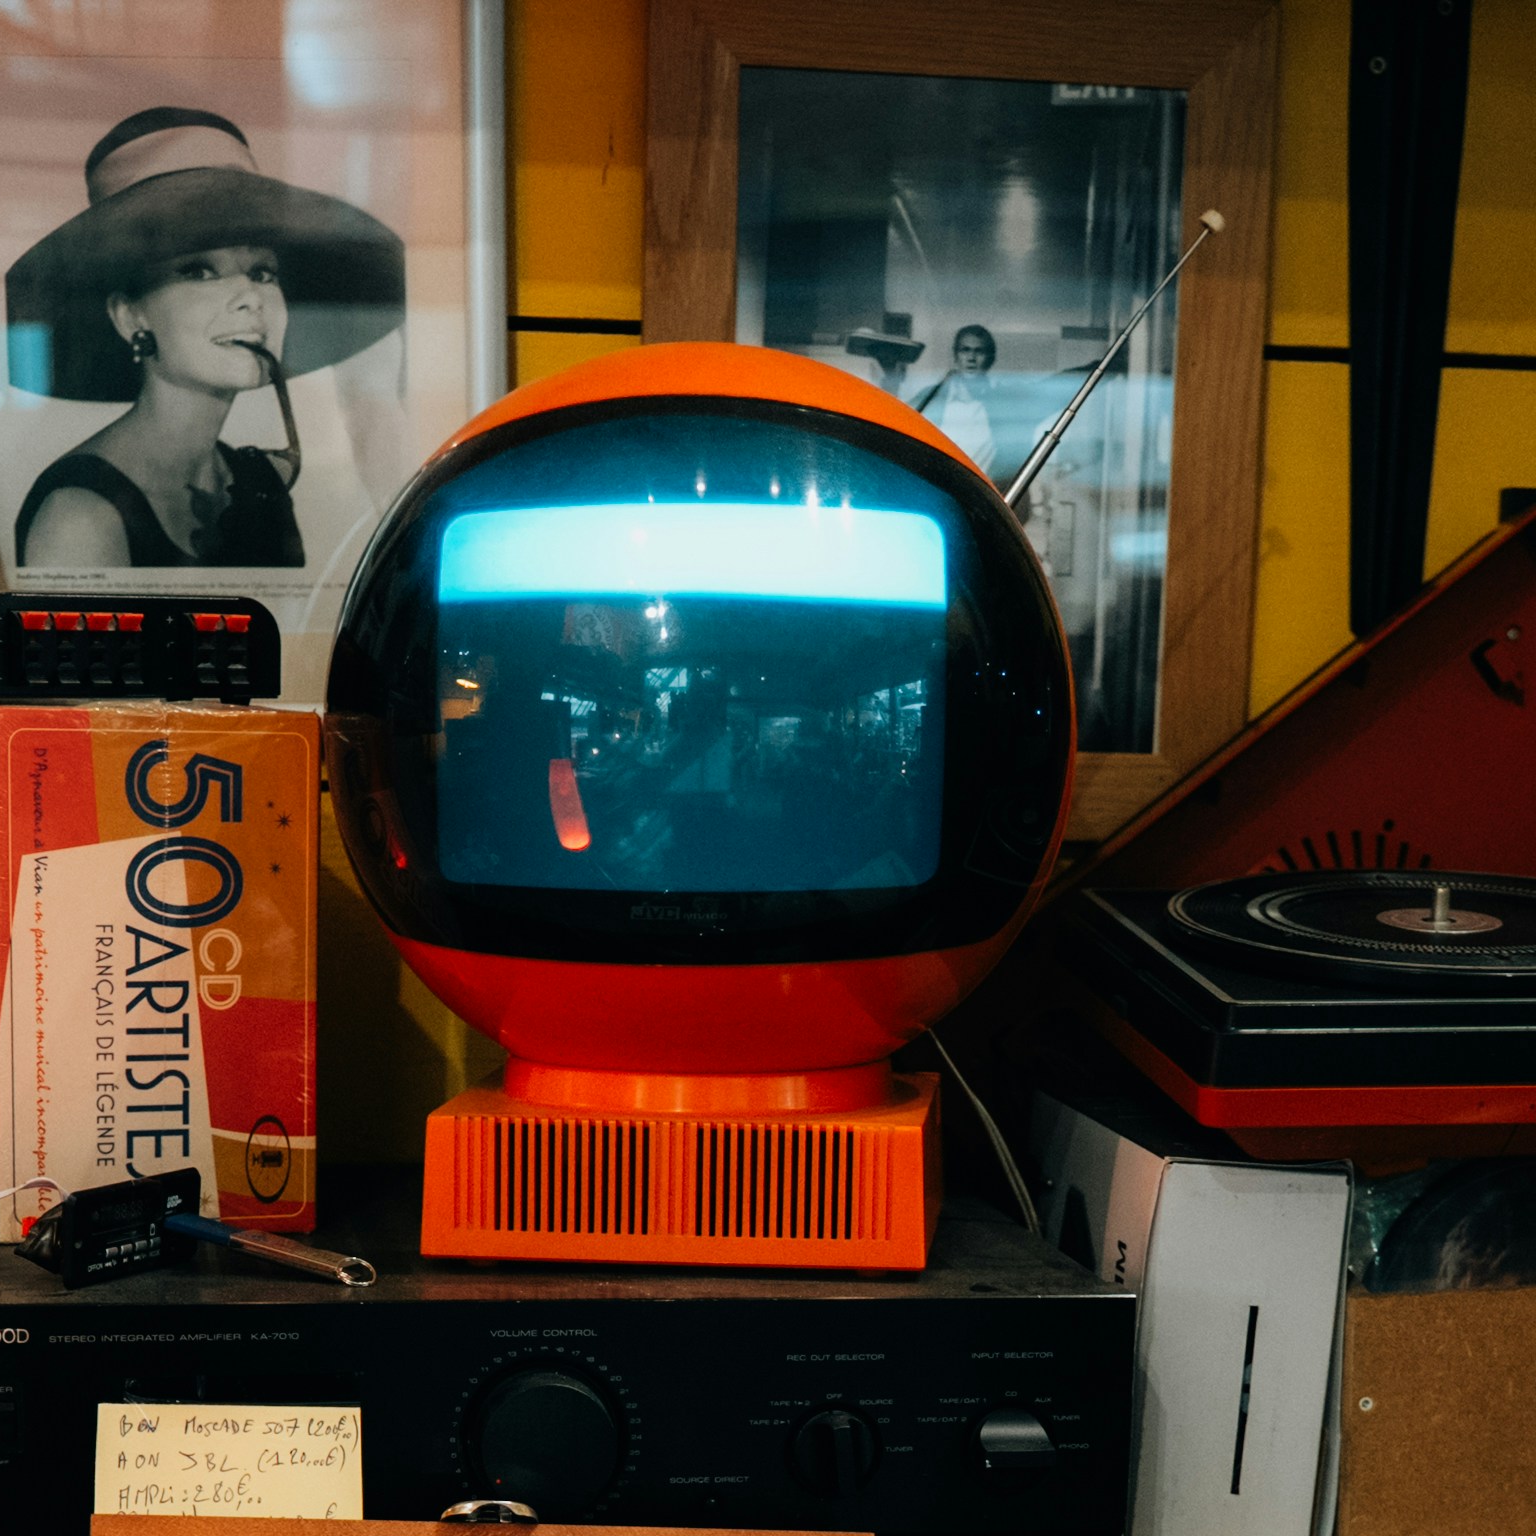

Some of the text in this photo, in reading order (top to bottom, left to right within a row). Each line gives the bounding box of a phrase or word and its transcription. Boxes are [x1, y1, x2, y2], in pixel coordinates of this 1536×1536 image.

[125, 738, 244, 929] 50
[33, 856, 49, 897] Vian
[35, 901, 43, 922] un
[28, 927, 46, 1026] patrimoine
[198, 928, 242, 1011] CD
[92, 924, 116, 1168] FRANÇAIS DE LÉGENDE
[34, 1029, 47, 1091] musical
[30, 1096, 47, 1212] incomparble
[48, 1331, 300, 1343] STEREO INTEGRATED AMPLIFIER KA-7010
[490, 1328, 598, 1339] VOLUME CONTROL
[786, 1352, 885, 1362] REC OUT SELECTOR
[971, 1350, 1054, 1359] INPUT SELECTOR
[1052, 1412, 1081, 1421] TUNER
[885, 1444, 914, 1453] TUNER
[669, 1475, 750, 1484] SOURCE DIRECT
